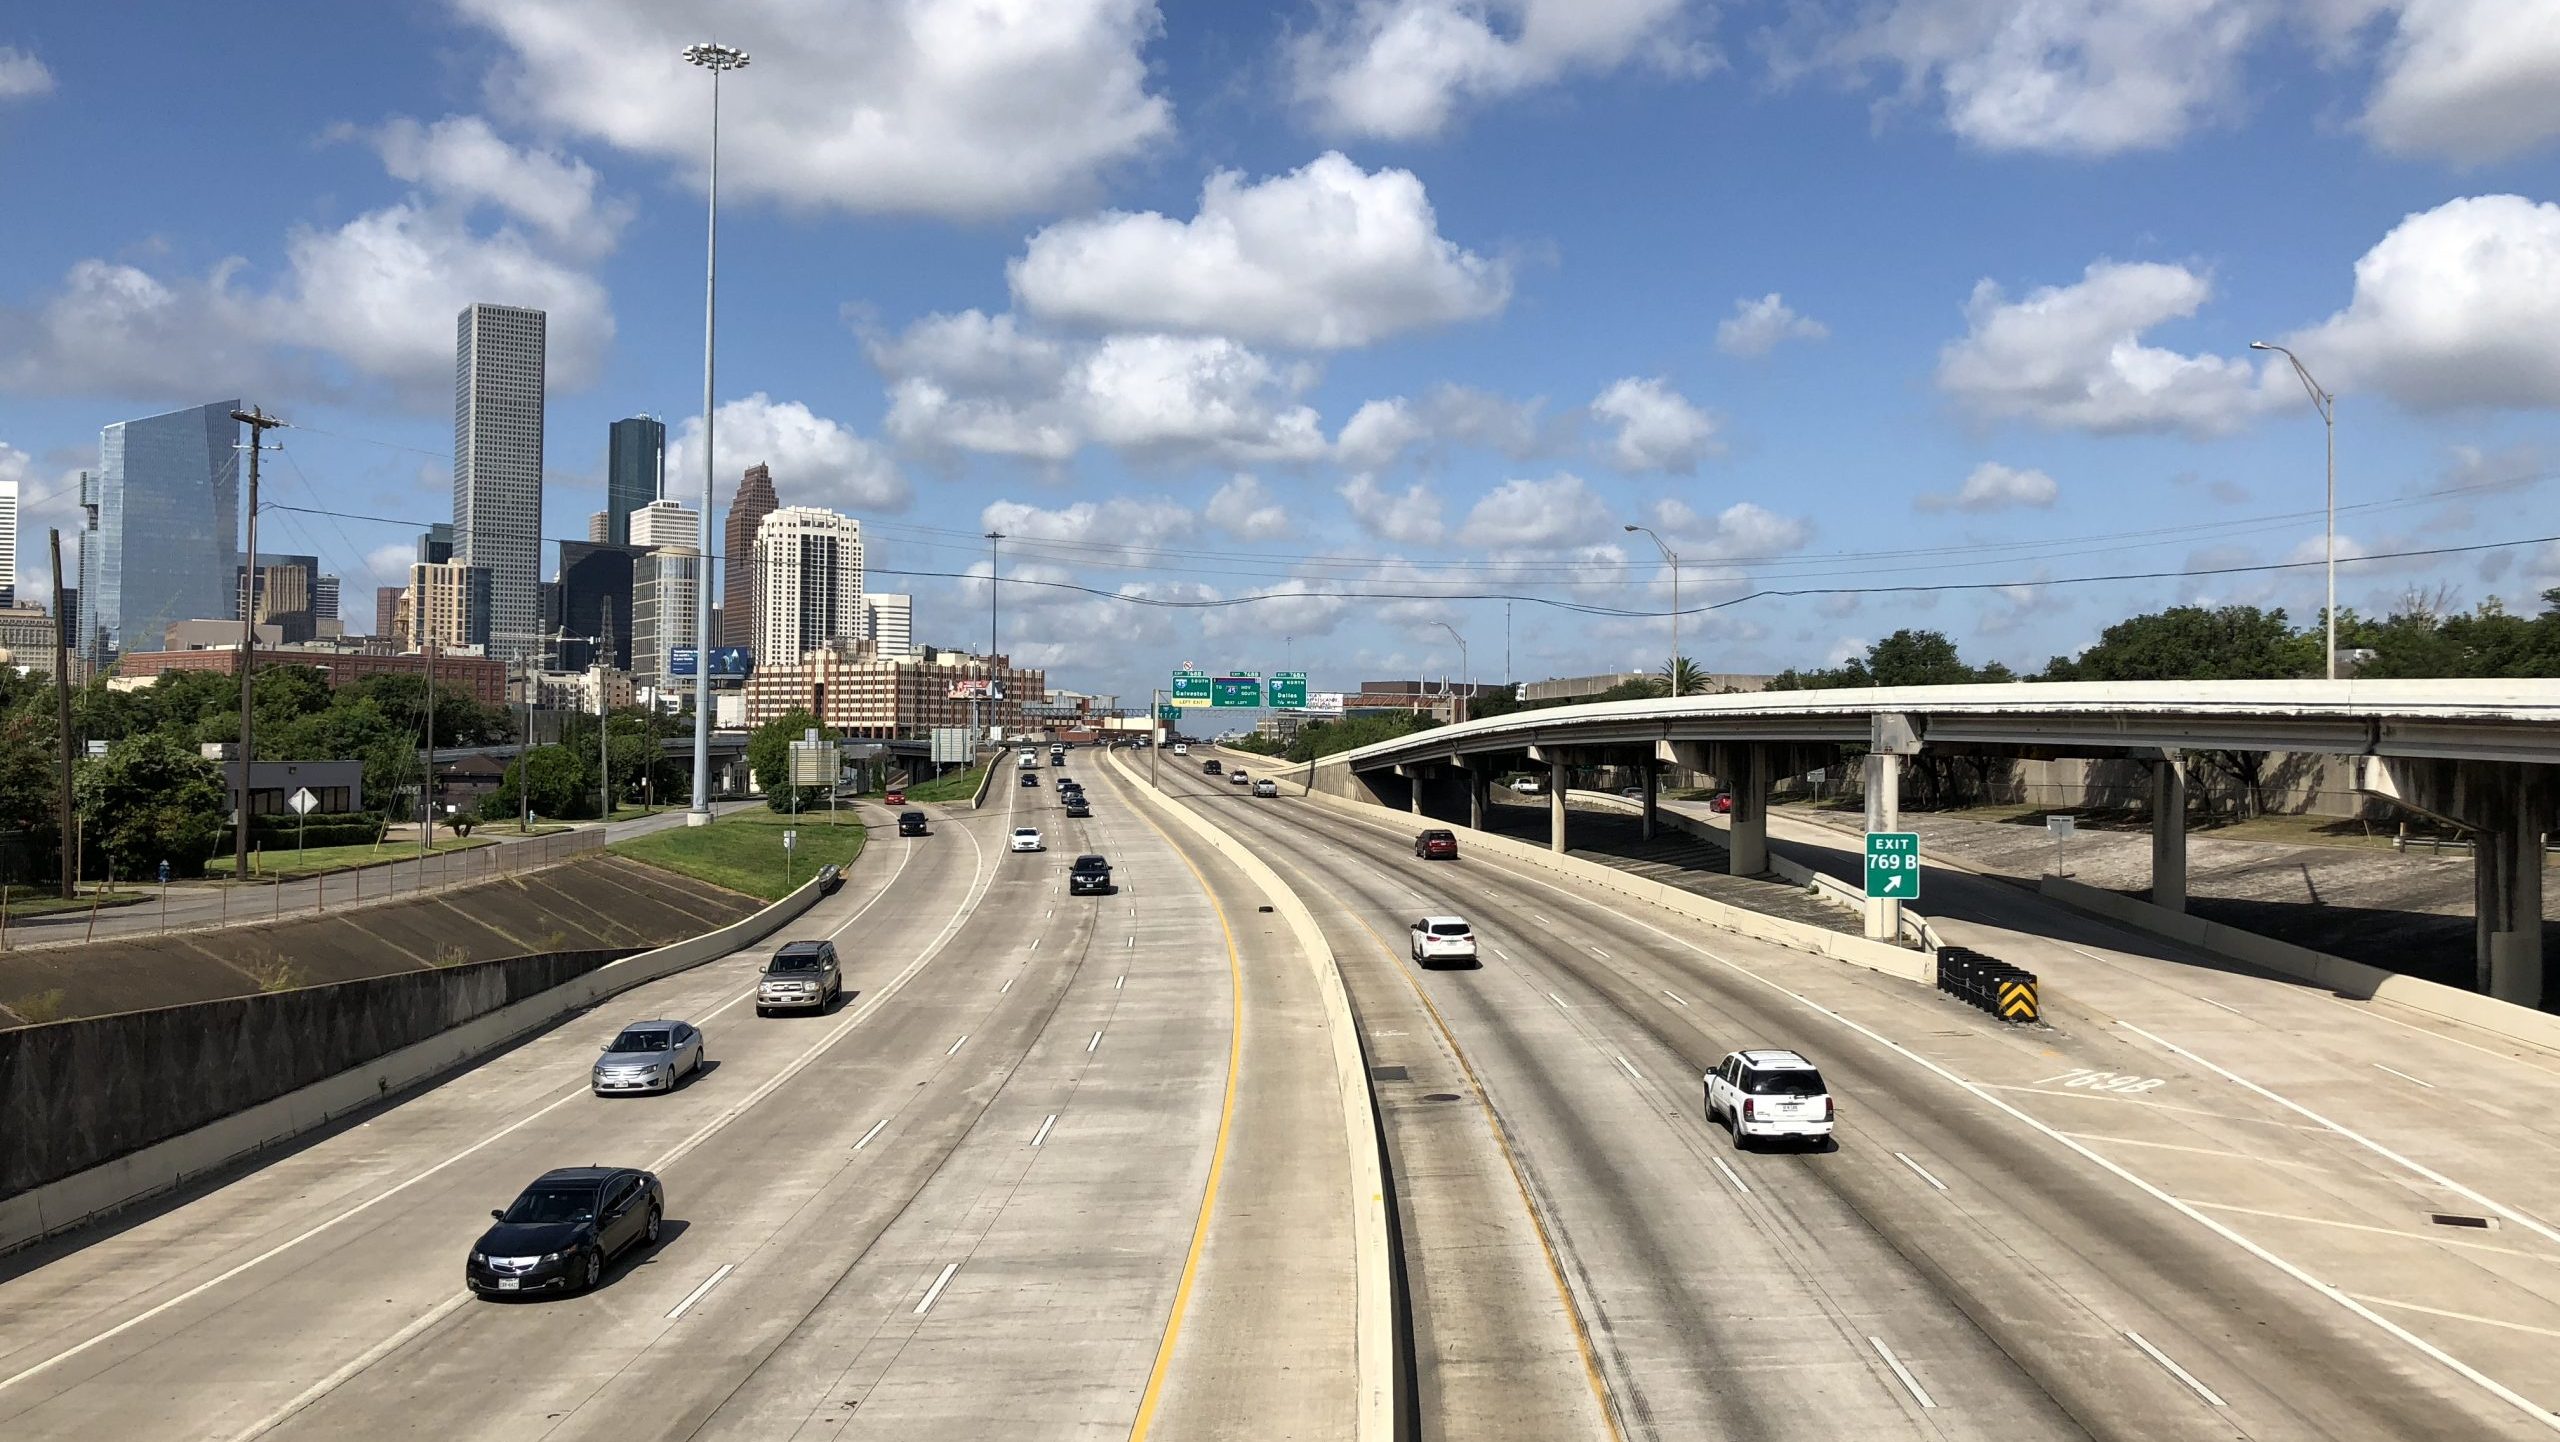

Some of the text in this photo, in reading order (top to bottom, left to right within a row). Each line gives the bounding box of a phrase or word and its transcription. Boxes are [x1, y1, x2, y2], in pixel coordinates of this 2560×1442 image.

[1875, 839, 1909, 850] EXIT
[1868, 854, 1917, 869] 769 B
[2033, 1068, 2166, 1093] 769B
